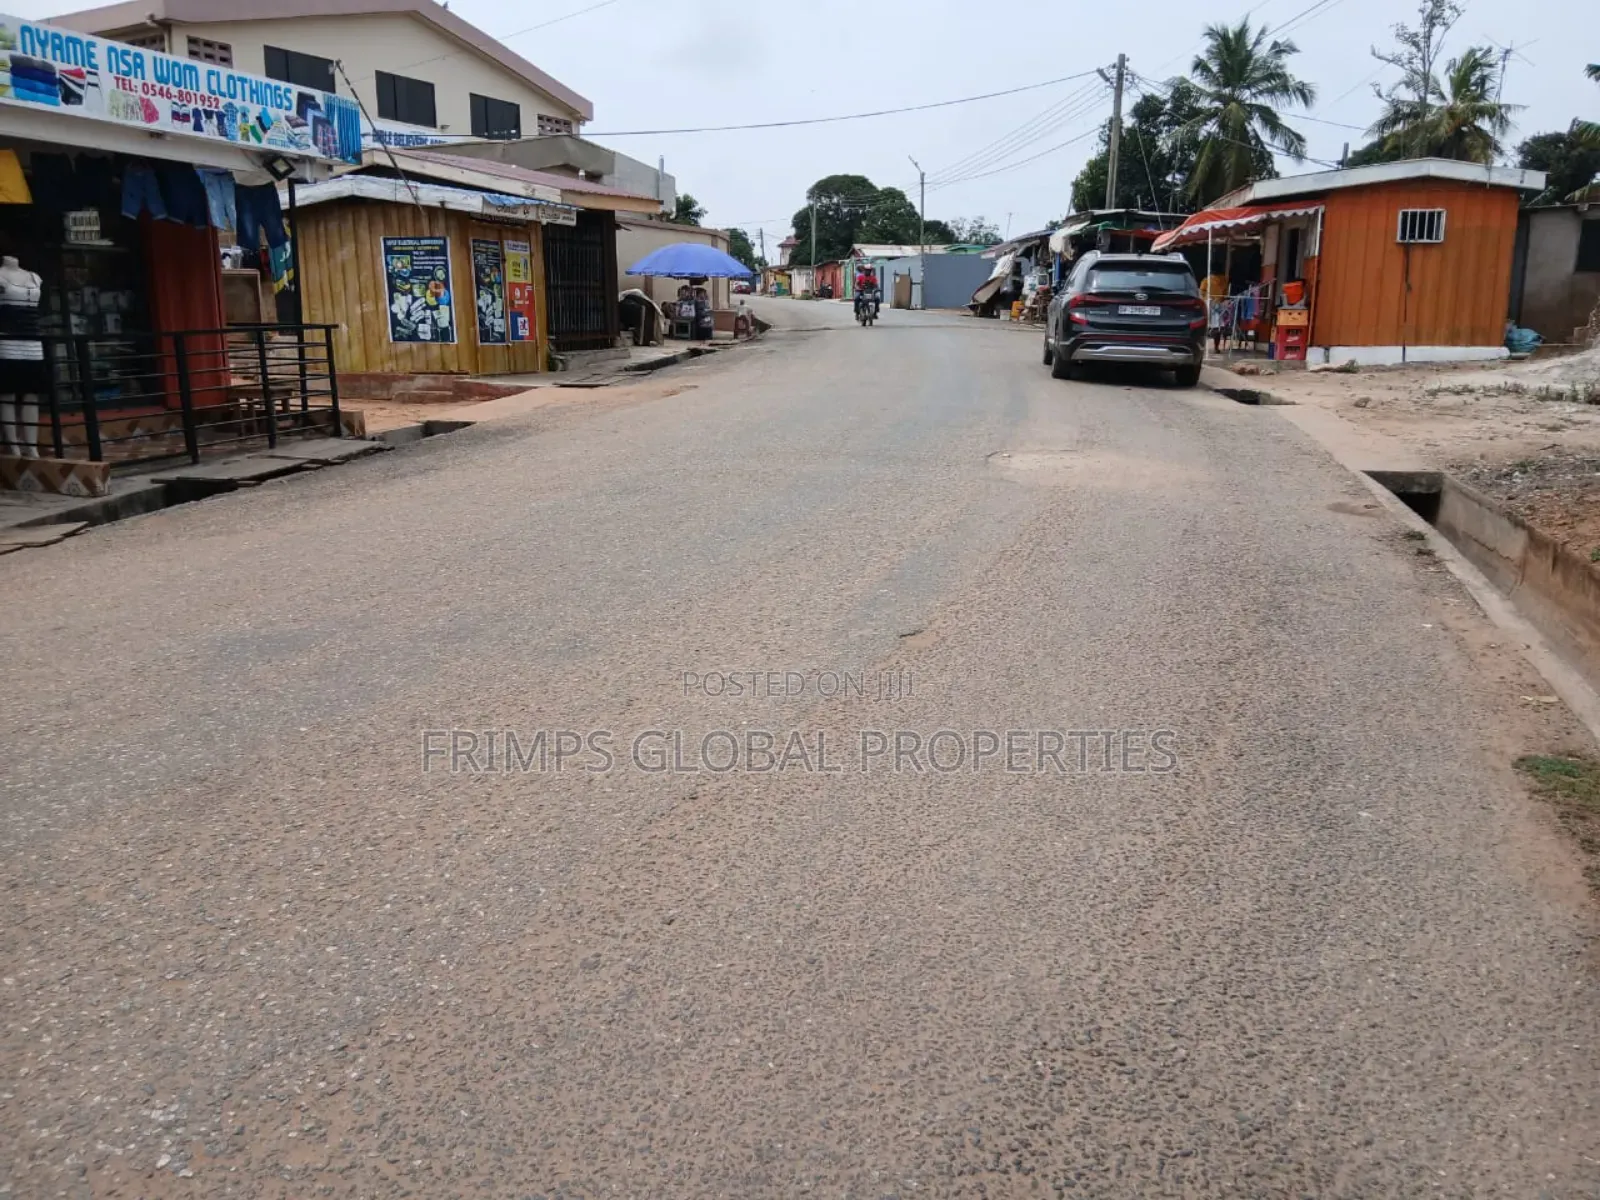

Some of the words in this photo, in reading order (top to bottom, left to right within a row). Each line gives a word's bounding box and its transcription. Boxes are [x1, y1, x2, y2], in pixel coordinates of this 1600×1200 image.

[20, 24, 99, 70] NYAME
[107, 45, 145, 80] NSA
[153, 56, 200, 92] WOM
[206, 69, 293, 111] CLOTHINGS
[113, 76, 138, 93] TEL:
[142, 82, 220, 109] 0546-801952
